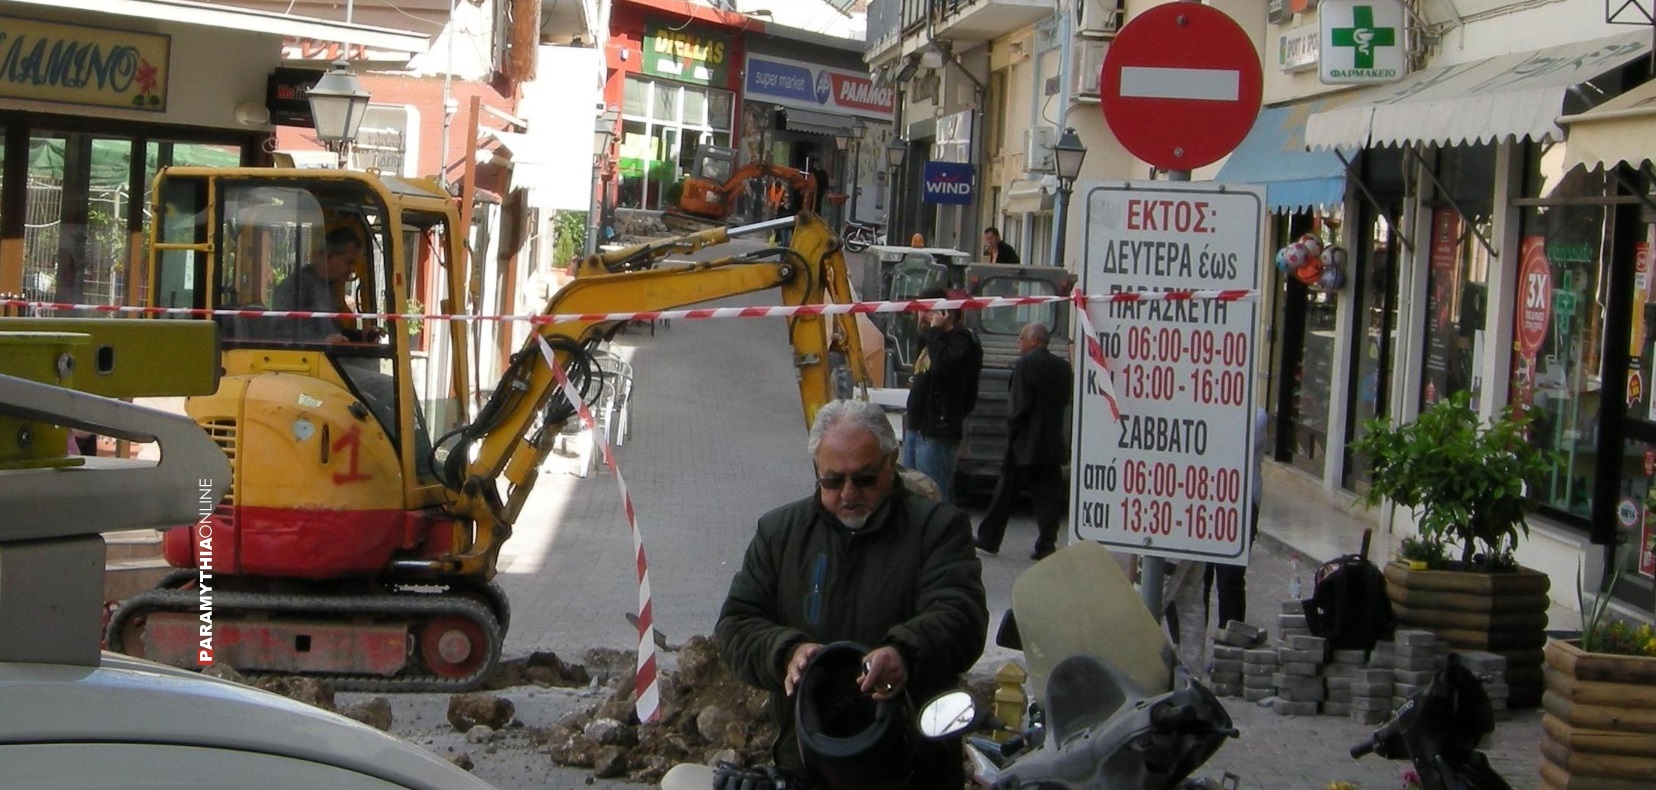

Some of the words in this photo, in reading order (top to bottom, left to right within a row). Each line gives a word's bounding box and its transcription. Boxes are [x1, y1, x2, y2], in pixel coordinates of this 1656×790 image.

[654, 29, 725, 64] DIELLAS
[755, 71, 777, 89] super
[779, 74, 805, 91] market
[1330, 69, 1396, 78] ΦΑΡΜΑΚΕΙΟ
[926, 181, 971, 195] WIND
[1127, 199, 1217, 233] ΕΚΤΟΣ:
[1103, 239, 1192, 278] ΔΕΥΤΕΡΑ
[1198, 243, 1238, 280] έως
[1109, 284, 1228, 325] ΠΑΡΑΣΚΕΥΗ
[1526, 273, 1548, 309] 3X
[1127, 325, 1248, 368] 06:00-09-00
[1123, 363, 1175, 401] 13:00
[1191, 368, 1245, 407] 16:00
[331, 422, 374, 486] 1
[1118, 414, 1208, 456] ΣΑΒΒΑΤΟ
[1083, 458, 1117, 492] από
[1123, 459, 1240, 504] 06:00-08:00
[1082, 501, 1110, 529] και
[1120, 496, 1172, 536] 13:30
